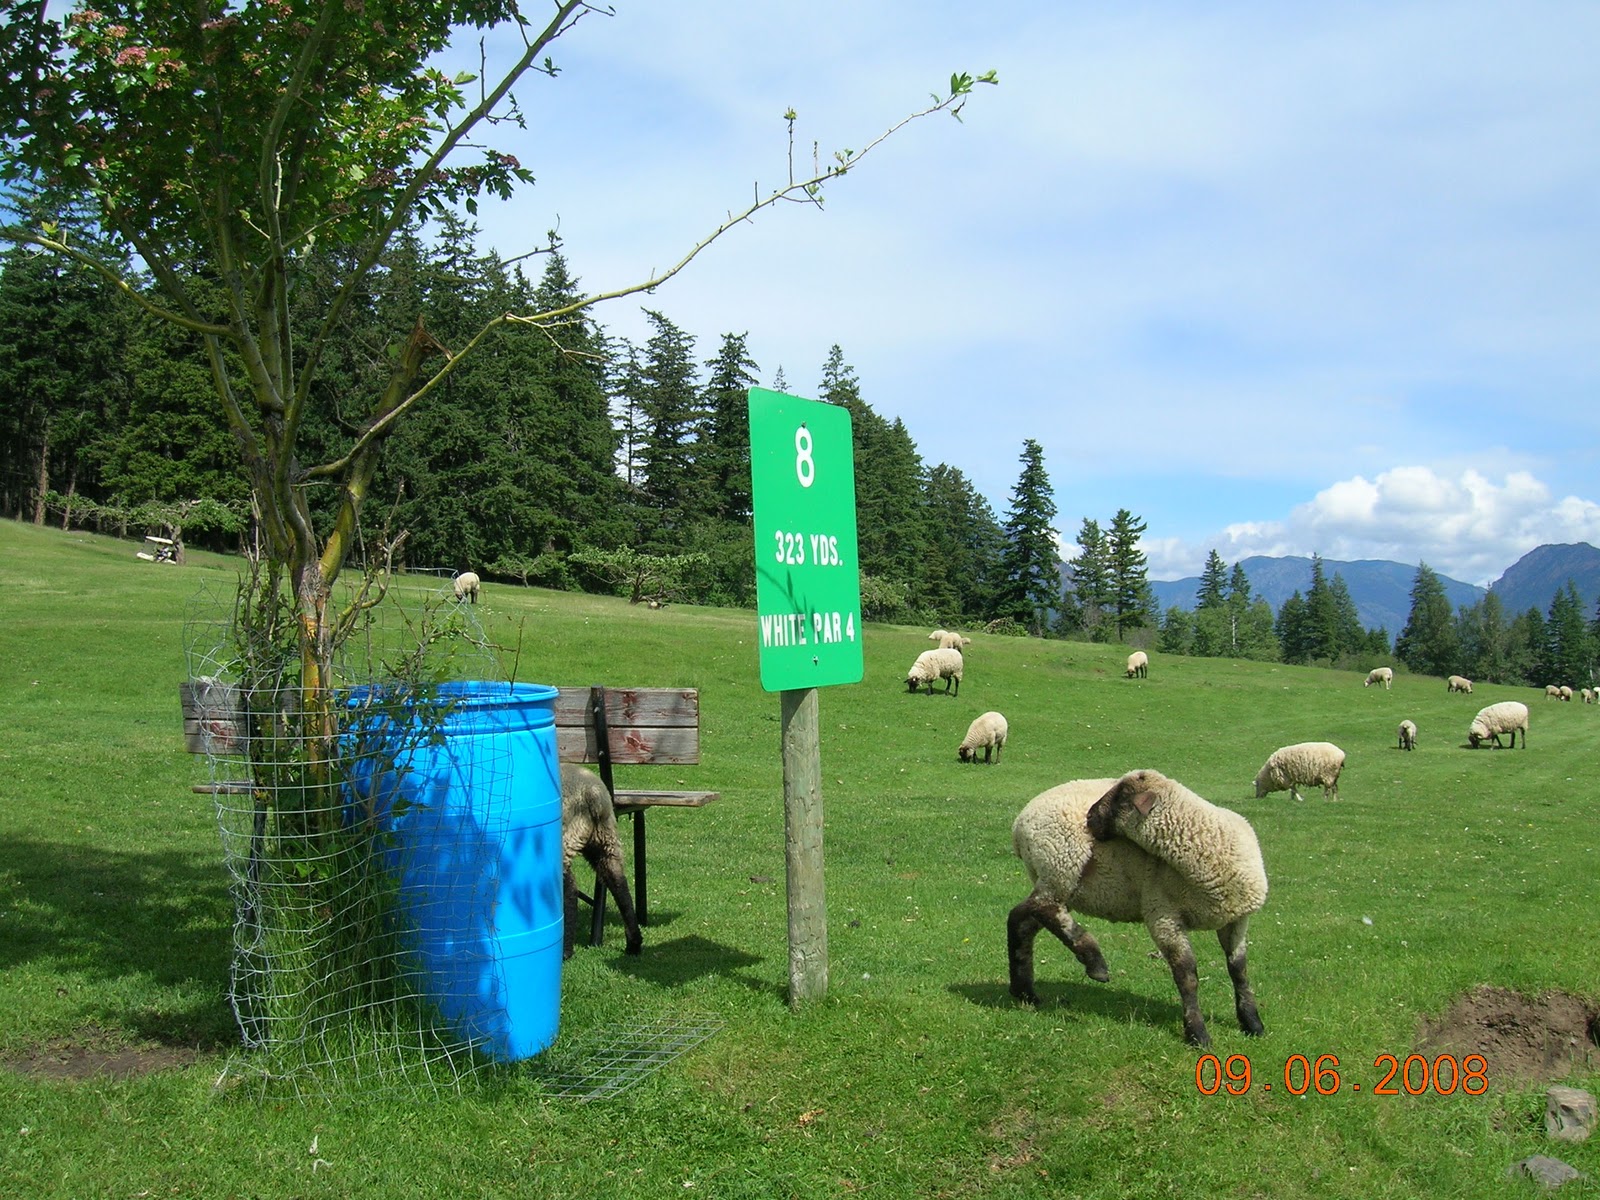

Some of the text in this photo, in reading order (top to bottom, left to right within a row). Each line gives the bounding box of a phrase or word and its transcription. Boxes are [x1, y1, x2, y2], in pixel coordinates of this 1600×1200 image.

[794, 426, 815, 488] 8
[775, 530, 843, 566] 323 YDS.
[760, 612, 855, 648] WHITE PAR 4
